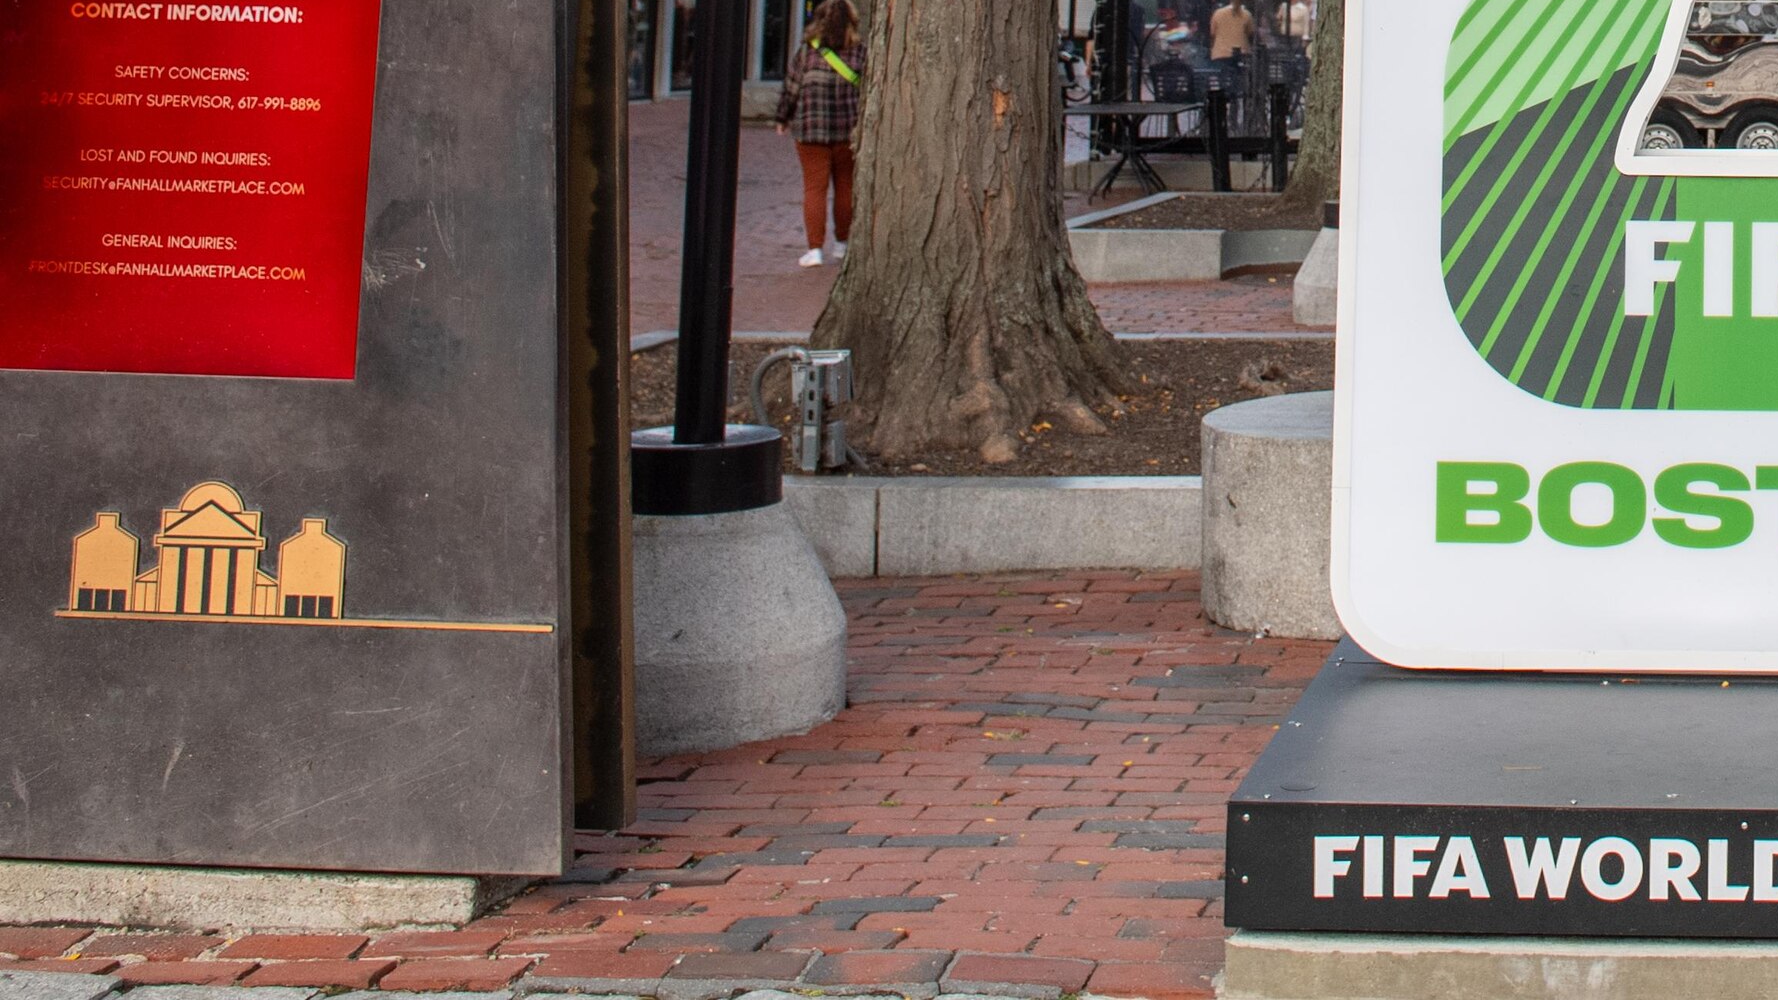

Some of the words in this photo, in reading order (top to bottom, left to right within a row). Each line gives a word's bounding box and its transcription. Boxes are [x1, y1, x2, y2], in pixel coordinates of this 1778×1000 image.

[71, 2, 163, 20] CONTACT
[167, 4, 303, 24] INFORMATION:
[115, 65, 165, 80] SAFETY
[168, 66, 250, 82] CONCERNS:
[77, 92, 142, 107] SECURITY
[146, 94, 235, 111] SUPERVISOR,
[238, 96, 321, 112] 617-991-8896
[80, 148, 114, 162] LOST
[117, 149, 145, 163] AND
[150, 150, 197, 165] FOUND
[201, 151, 271, 166] INQUIRIES:
[43, 176, 305, 196] SECURITY@FANHALLMARKETPLACE.COM
[102, 234, 163, 249] GENERAL
[167, 235, 237, 251] INQUIRIES:
[1313, 835, 1491, 899] FIFA
